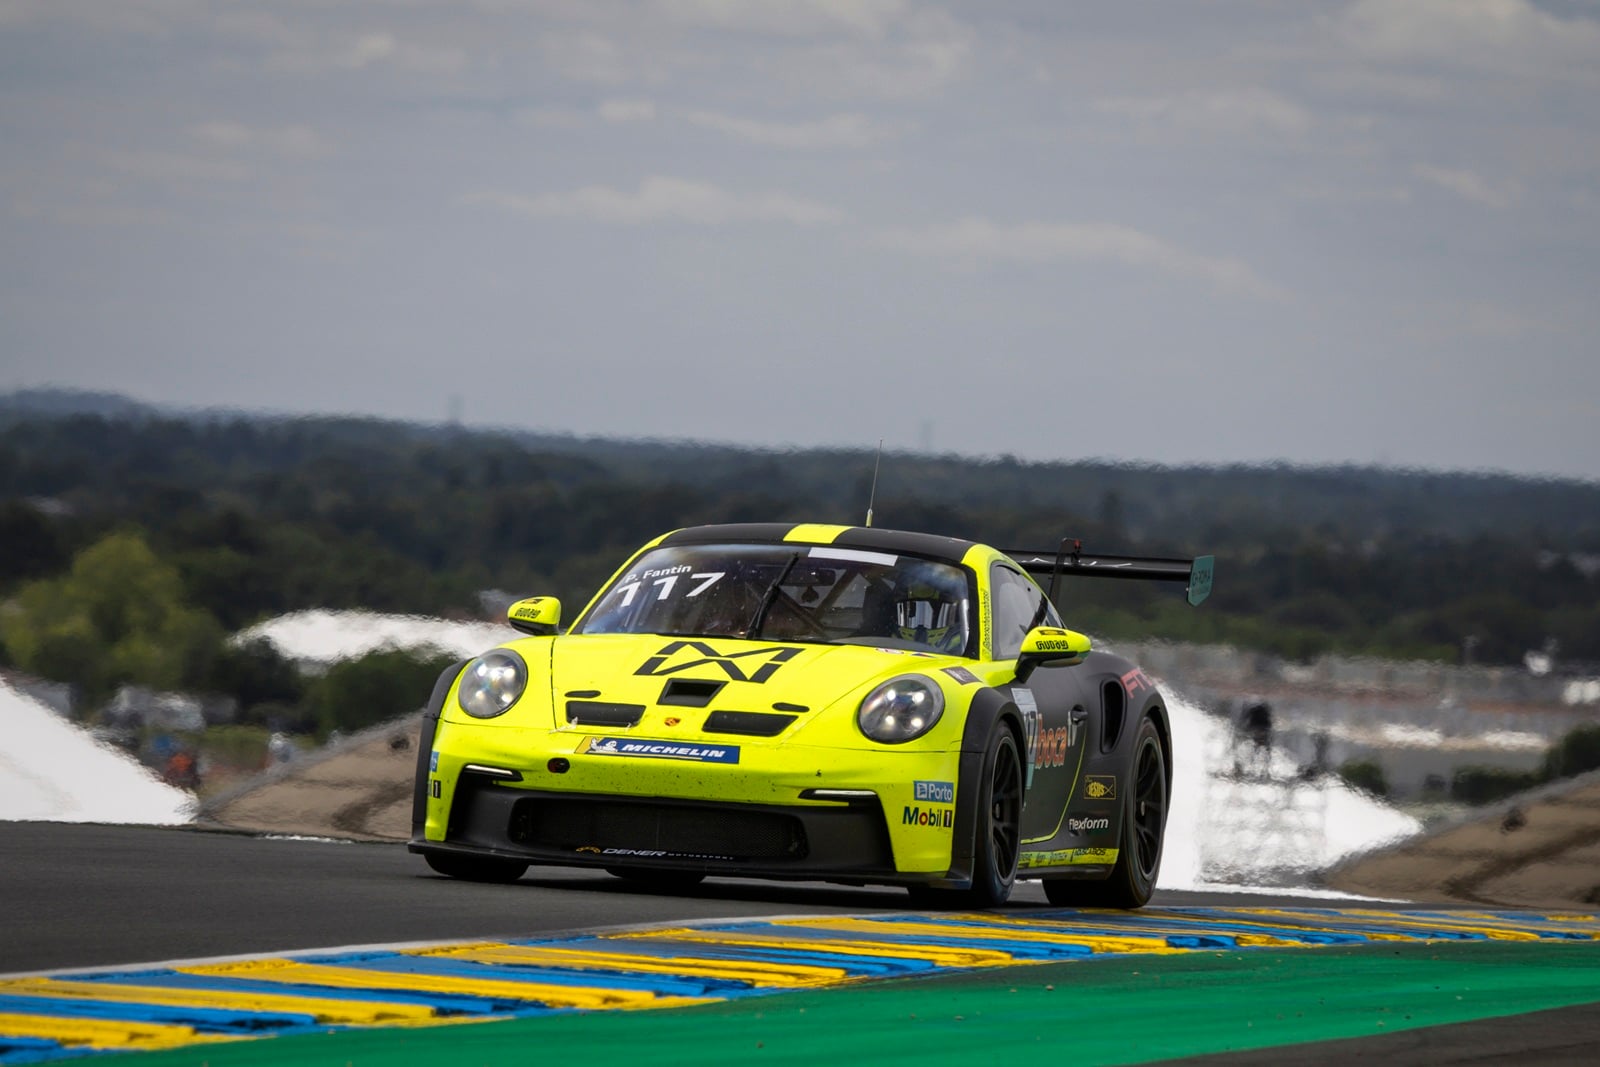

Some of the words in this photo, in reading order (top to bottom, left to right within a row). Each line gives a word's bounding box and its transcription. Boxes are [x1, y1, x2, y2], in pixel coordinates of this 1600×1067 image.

[643, 565, 692, 579] Fantin
[617, 572, 726, 608] 117
[621, 743, 727, 757] MICHELIN
[928, 783, 953, 801] Porto
[902, 806, 942, 827] Mobil
[944, 810, 952, 827] 1
[1069, 817, 1109, 831] Flexform
[602, 848, 667, 857] DENER
